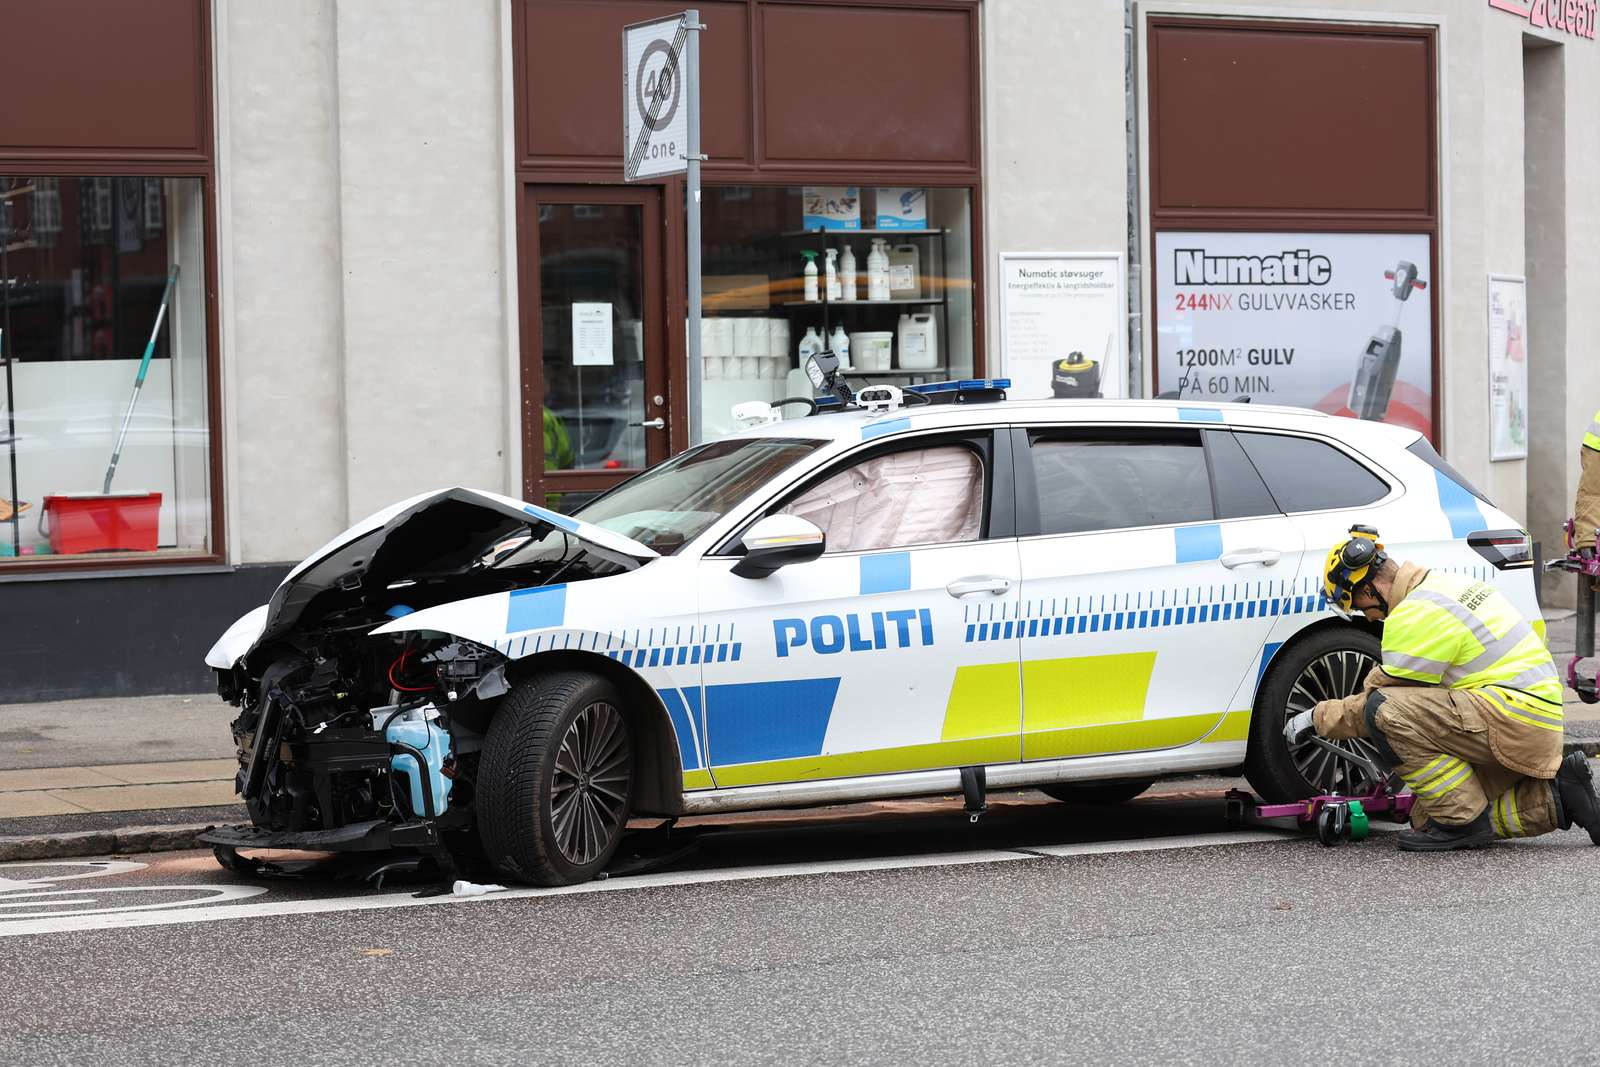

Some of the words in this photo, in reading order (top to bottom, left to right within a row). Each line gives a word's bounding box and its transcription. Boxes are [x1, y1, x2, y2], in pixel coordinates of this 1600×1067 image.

[644, 68, 673, 101] 40
[643, 141, 676, 161] Zone
[1018, 268, 1057, 279] Numatic
[1060, 269, 1104, 281] støvsuger
[1174, 249, 1332, 286] Numatic
[1175, 293, 1233, 311] 244NX
[1238, 293, 1356, 311] GULVVASKER
[1248, 348, 1295, 366] GULV
[1178, 371, 1203, 394] PÅ
[1208, 376, 1229, 394] 60
[1234, 376, 1275, 393] MIN.
[773, 608, 934, 657] POLITI
